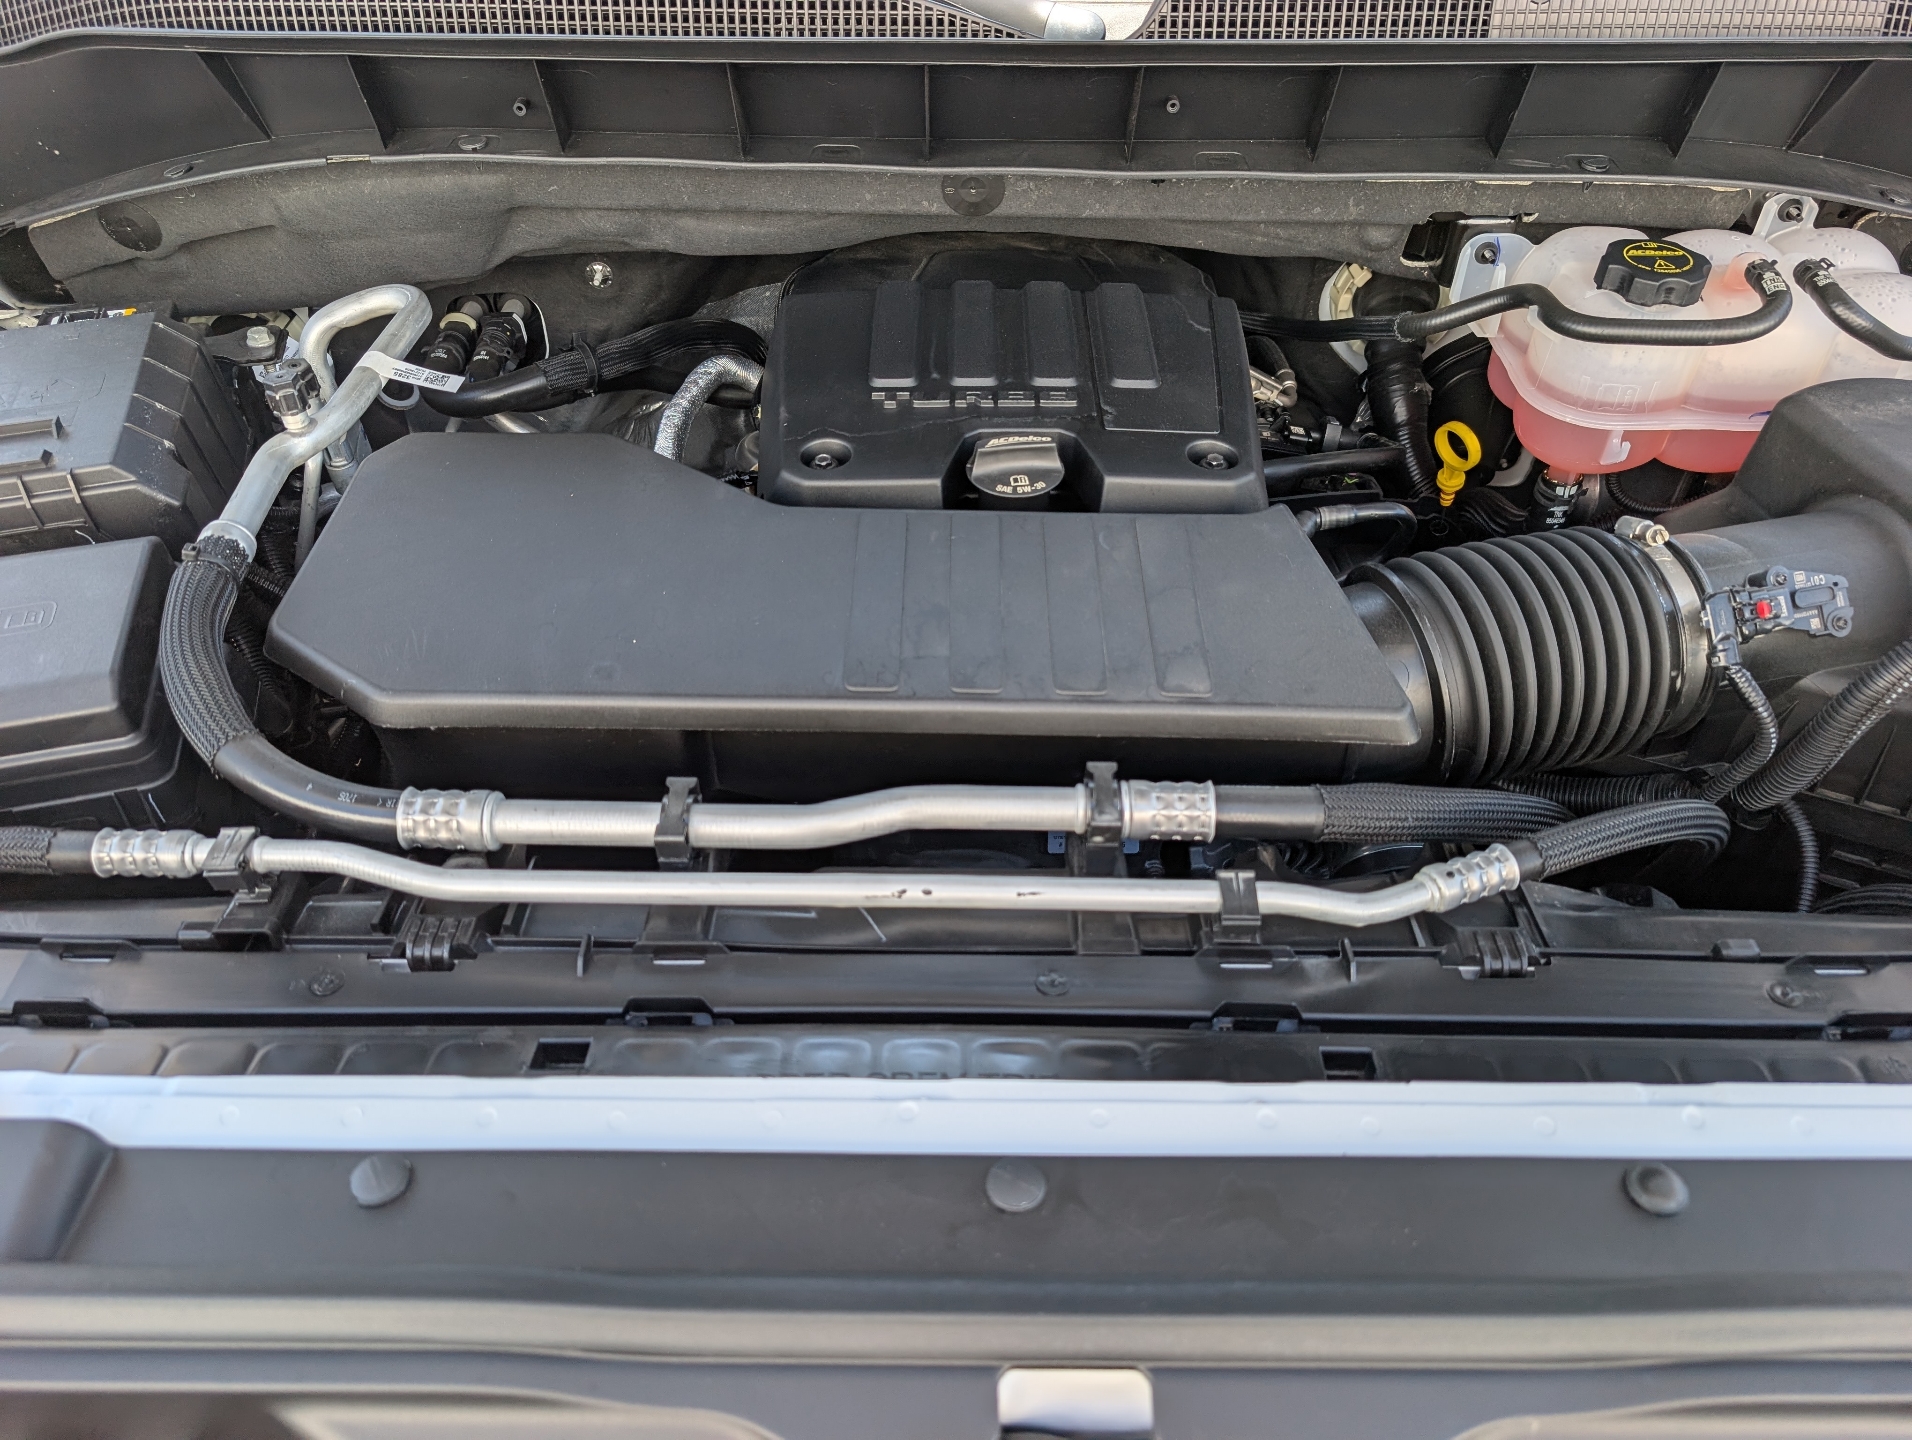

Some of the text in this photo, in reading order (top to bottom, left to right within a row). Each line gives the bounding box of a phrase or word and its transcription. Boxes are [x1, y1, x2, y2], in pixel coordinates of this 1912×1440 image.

[1626, 249, 1684, 257] ACDelco
[1762, 276, 1783, 287] TNK
[1767, 283, 1786, 294] ENG
[985, 436, 1052, 448] ACDelco
[995, 481, 1046, 493] SAE 5W-30
